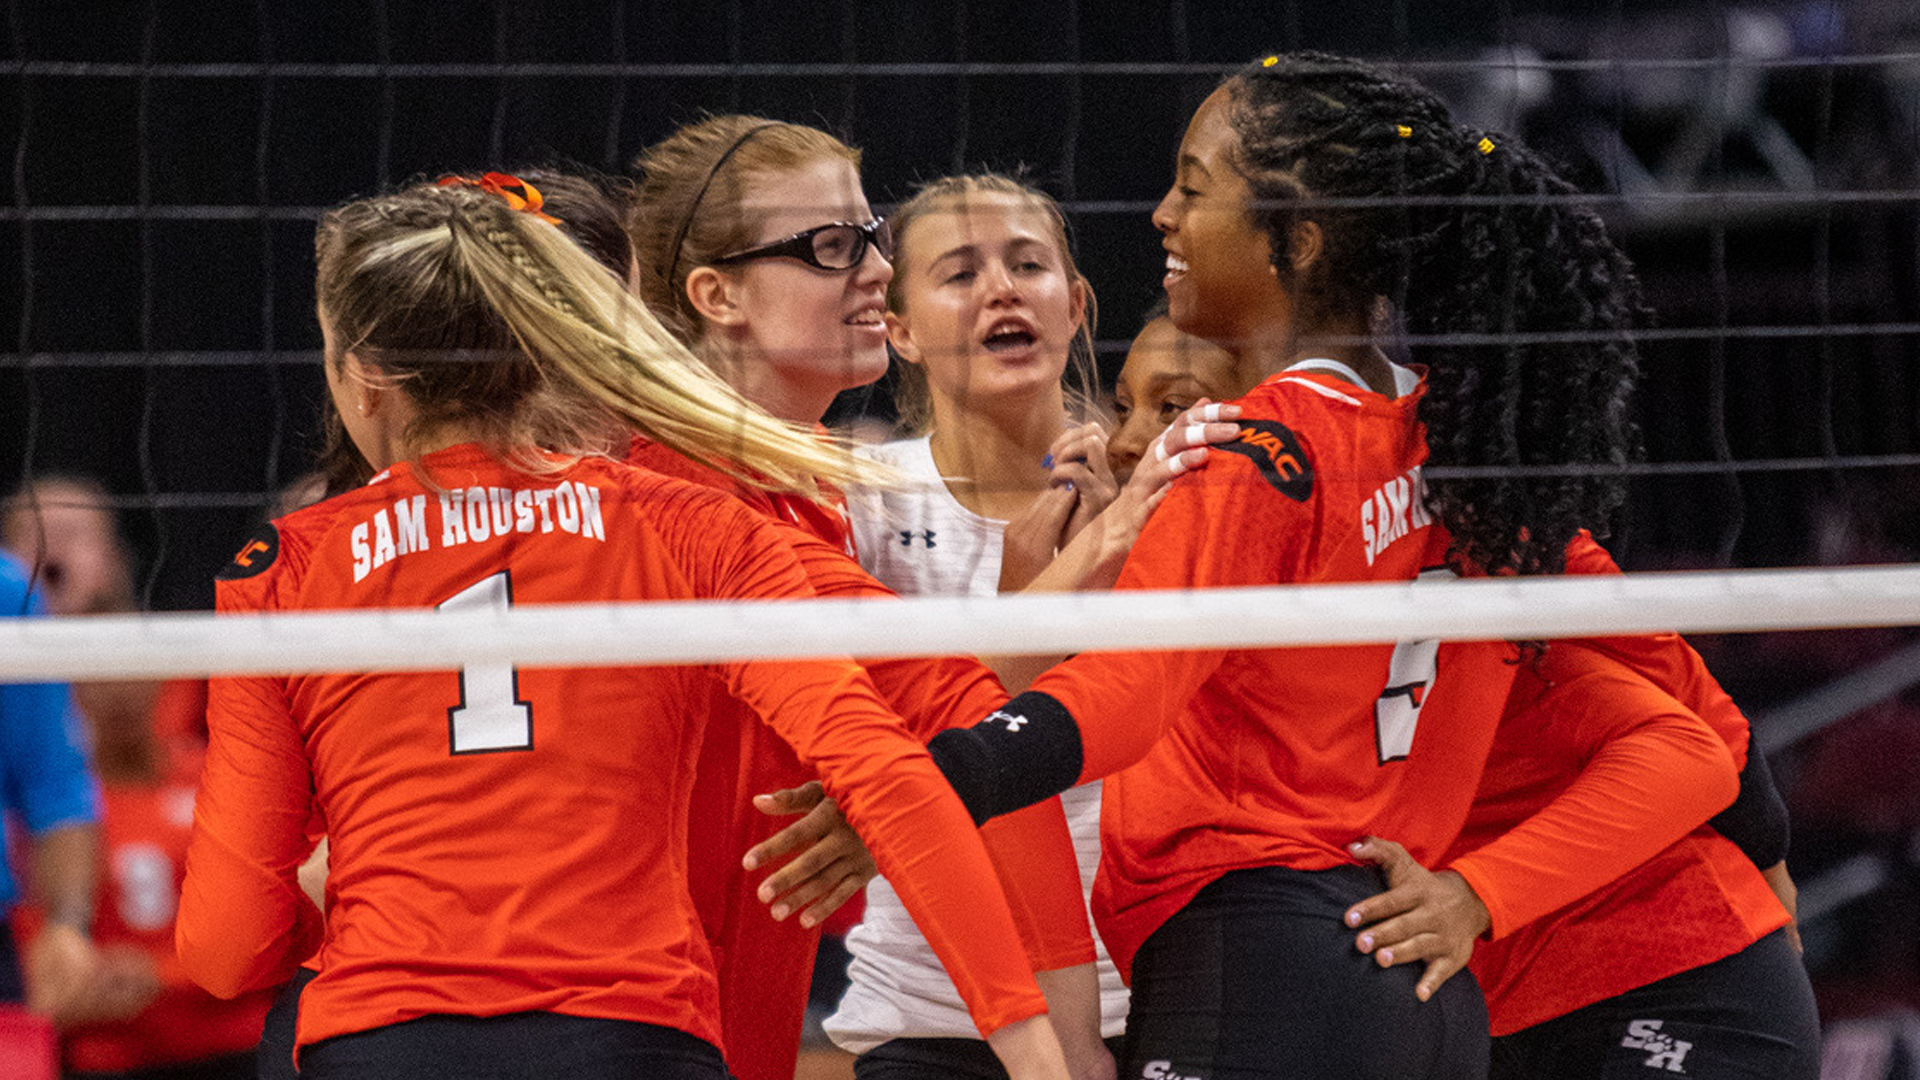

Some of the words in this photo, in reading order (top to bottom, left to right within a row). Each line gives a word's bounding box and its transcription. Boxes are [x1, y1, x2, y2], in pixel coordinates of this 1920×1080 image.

[351, 494, 430, 584] SAM
[439, 480, 606, 548] HOUSTON
[434, 569, 535, 756] 1
